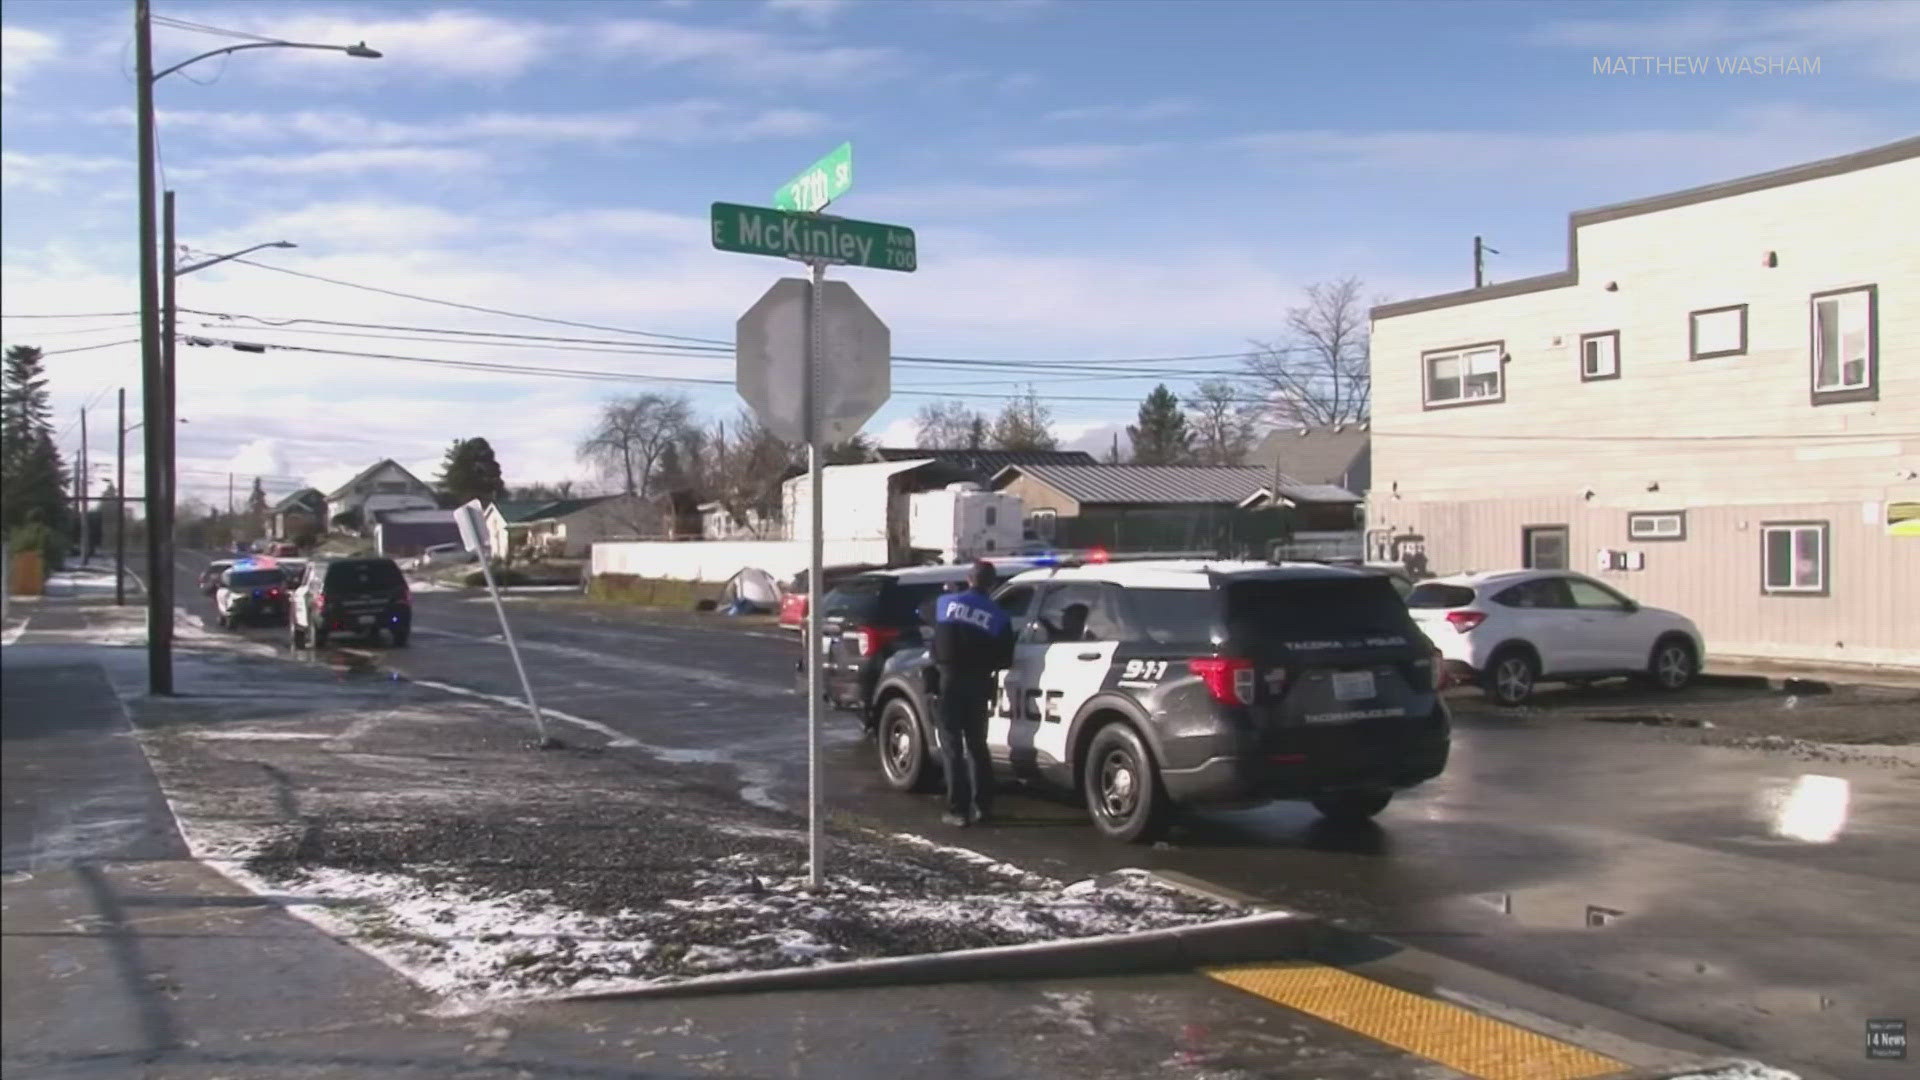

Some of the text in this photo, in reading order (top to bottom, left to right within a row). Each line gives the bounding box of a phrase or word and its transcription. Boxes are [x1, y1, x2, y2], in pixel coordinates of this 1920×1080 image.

[791, 168, 828, 211] 37th
[713, 212, 913, 265] E McKinley Ave
[885, 248, 915, 269] 700
[946, 601, 992, 630] POLICE
